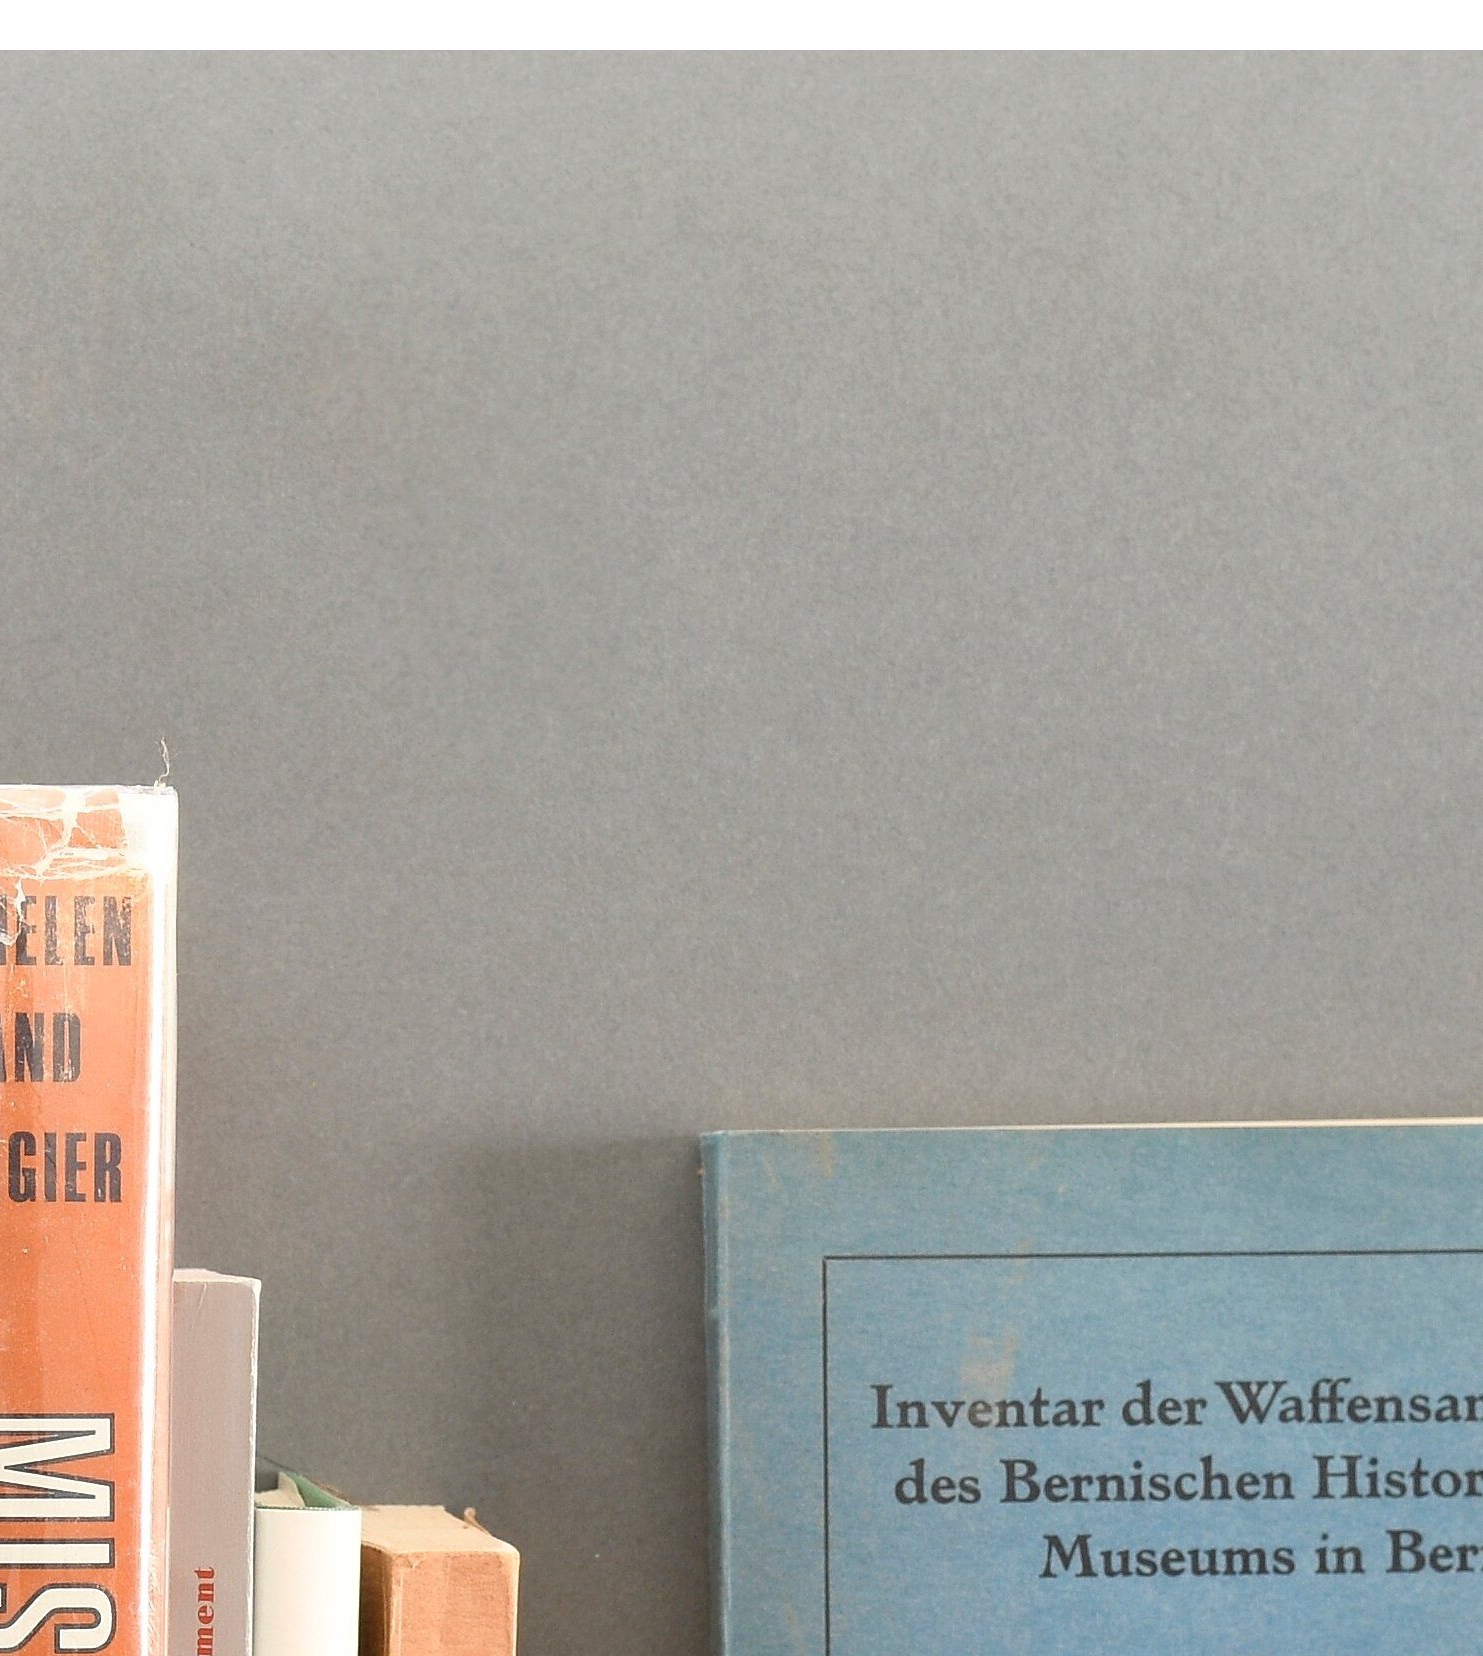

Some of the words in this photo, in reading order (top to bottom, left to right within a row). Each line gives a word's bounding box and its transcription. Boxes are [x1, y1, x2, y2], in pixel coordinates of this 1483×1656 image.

[871, 1384, 1104, 1429] Inventar
[1122, 1381, 1207, 1427] der
[895, 1459, 981, 1505] des
[1000, 1454, 1293, 1504] Bernischen
[1040, 1534, 1294, 1579] Museums
[1315, 1534, 1364, 1576] in
